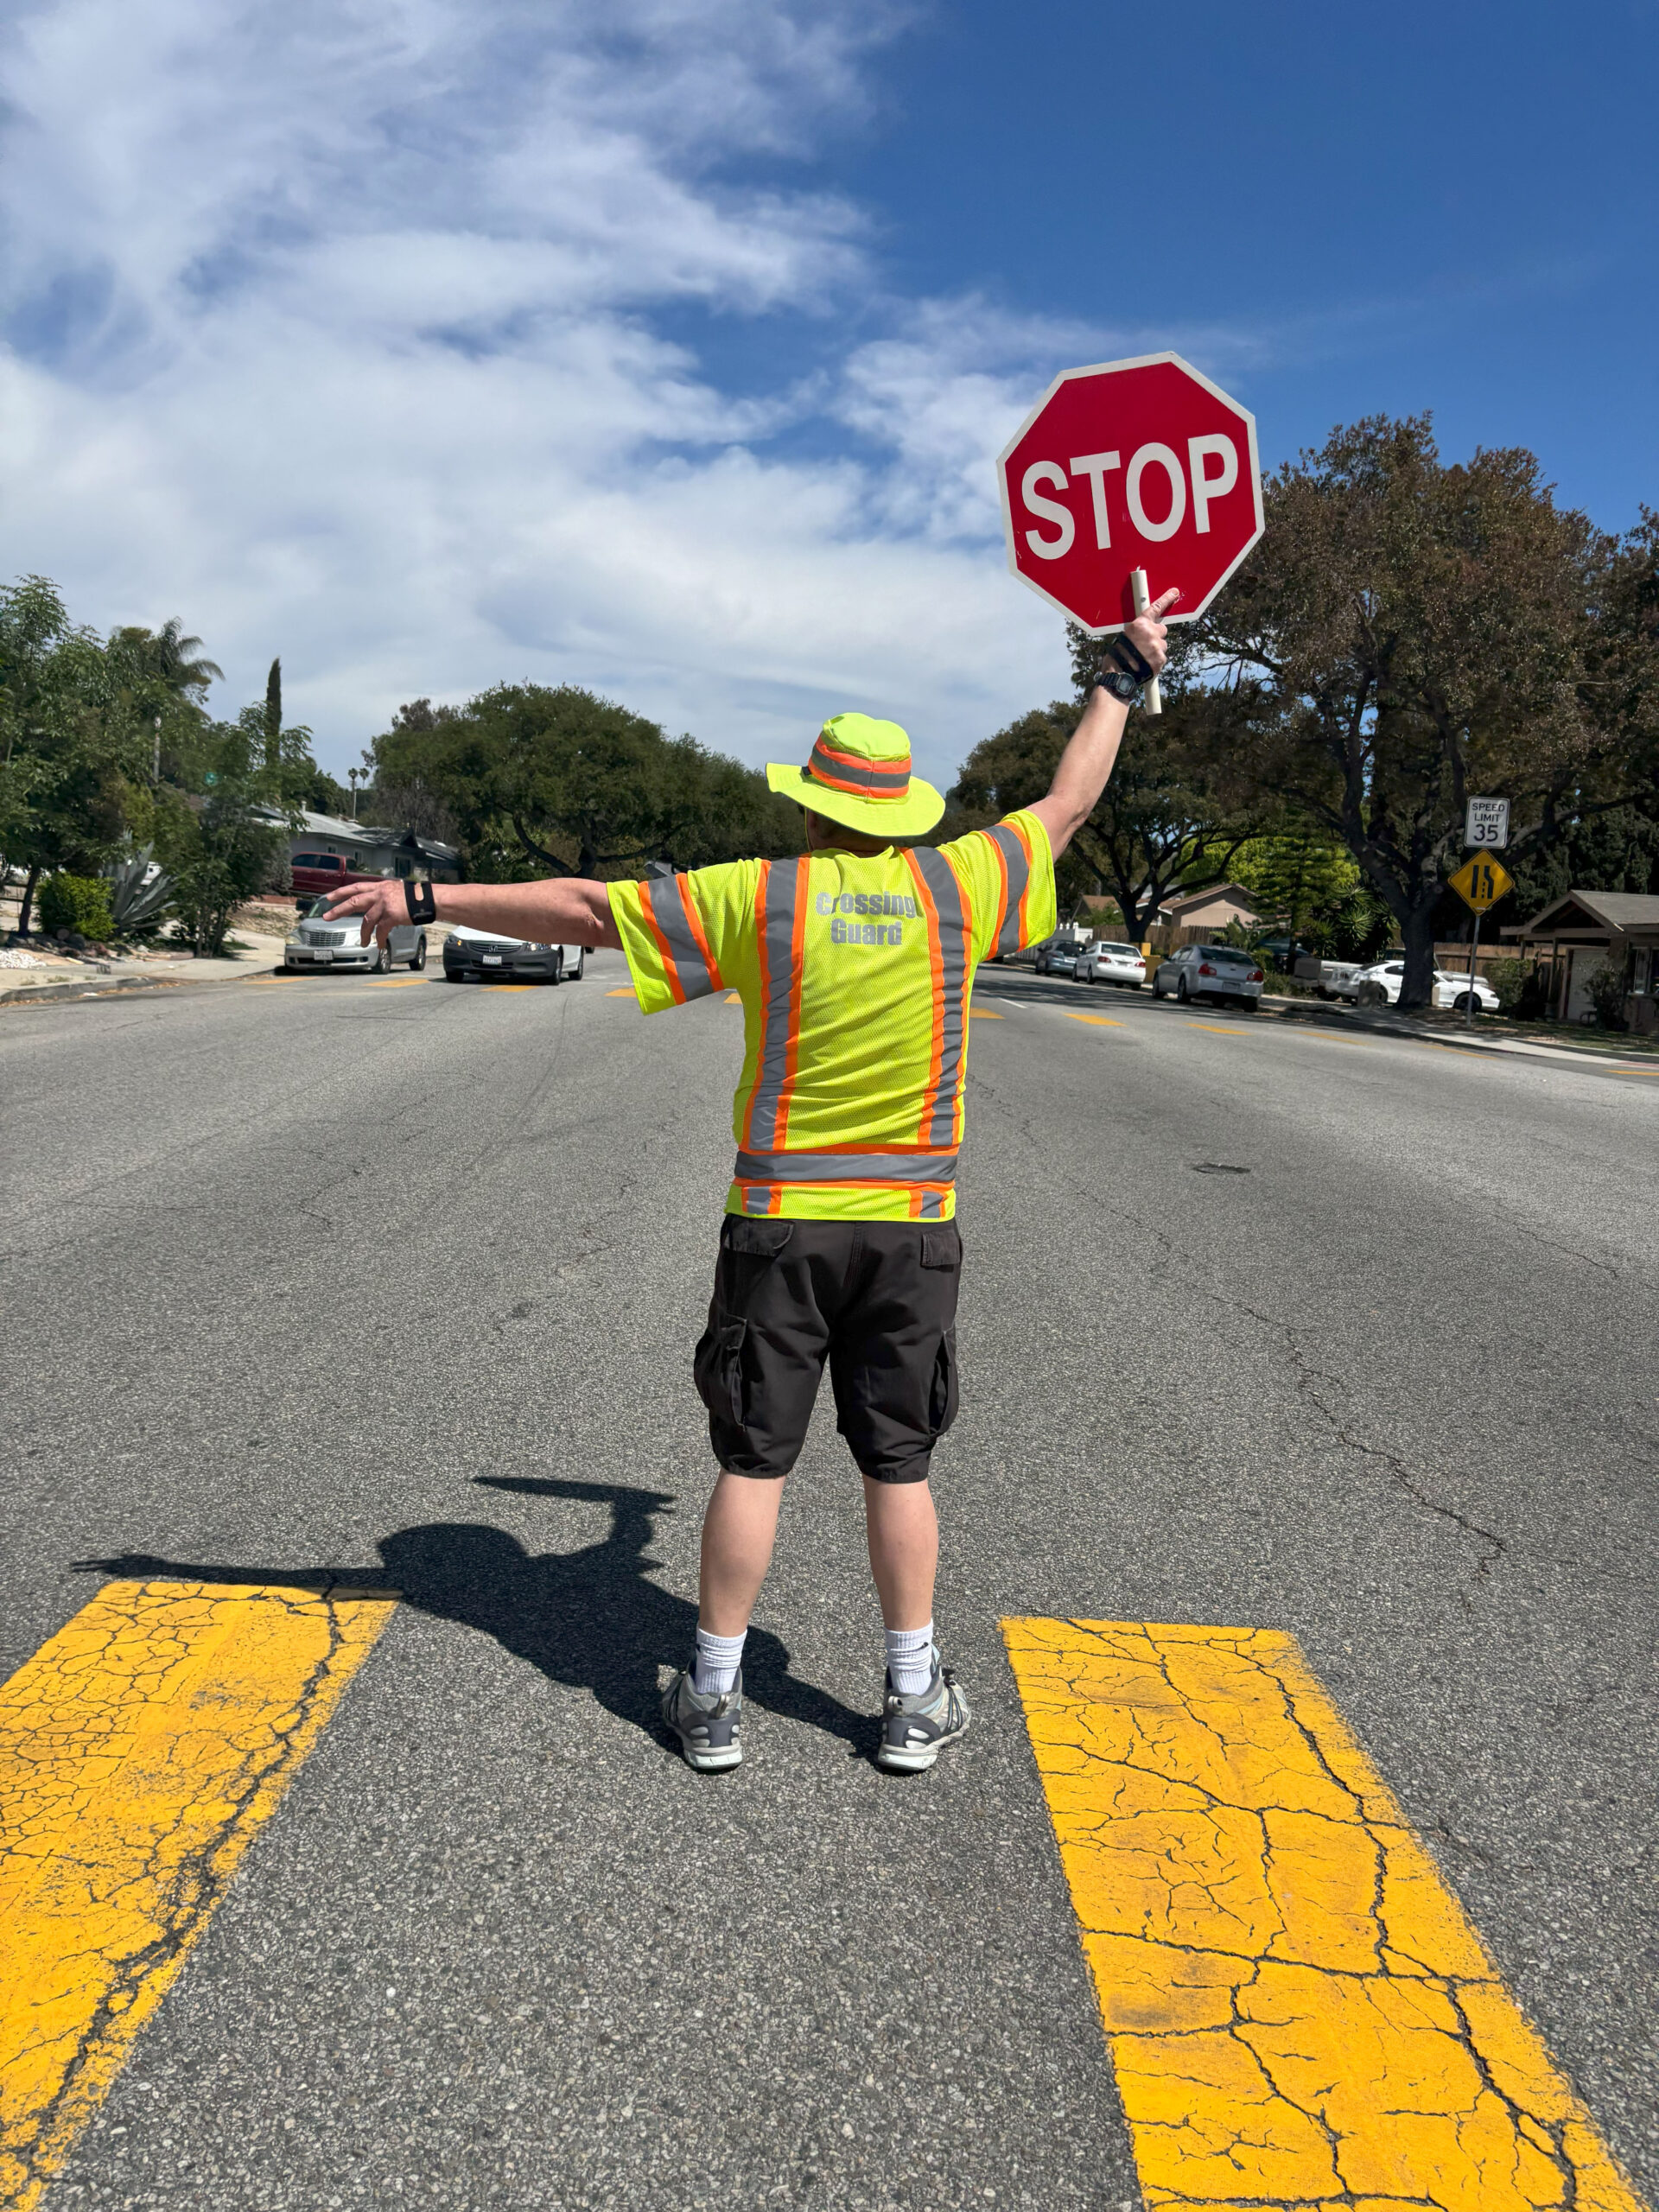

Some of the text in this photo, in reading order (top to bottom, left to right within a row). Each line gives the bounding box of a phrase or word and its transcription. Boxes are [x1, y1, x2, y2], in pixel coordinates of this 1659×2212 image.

[1021, 433, 1238, 561] STOP
[1471, 803, 1505, 812] SPEED
[1474, 813, 1500, 823] LIMIT
[1473, 823, 1499, 842] 35
[816, 891, 917, 918] Crossing
[830, 918, 903, 946] Guard
